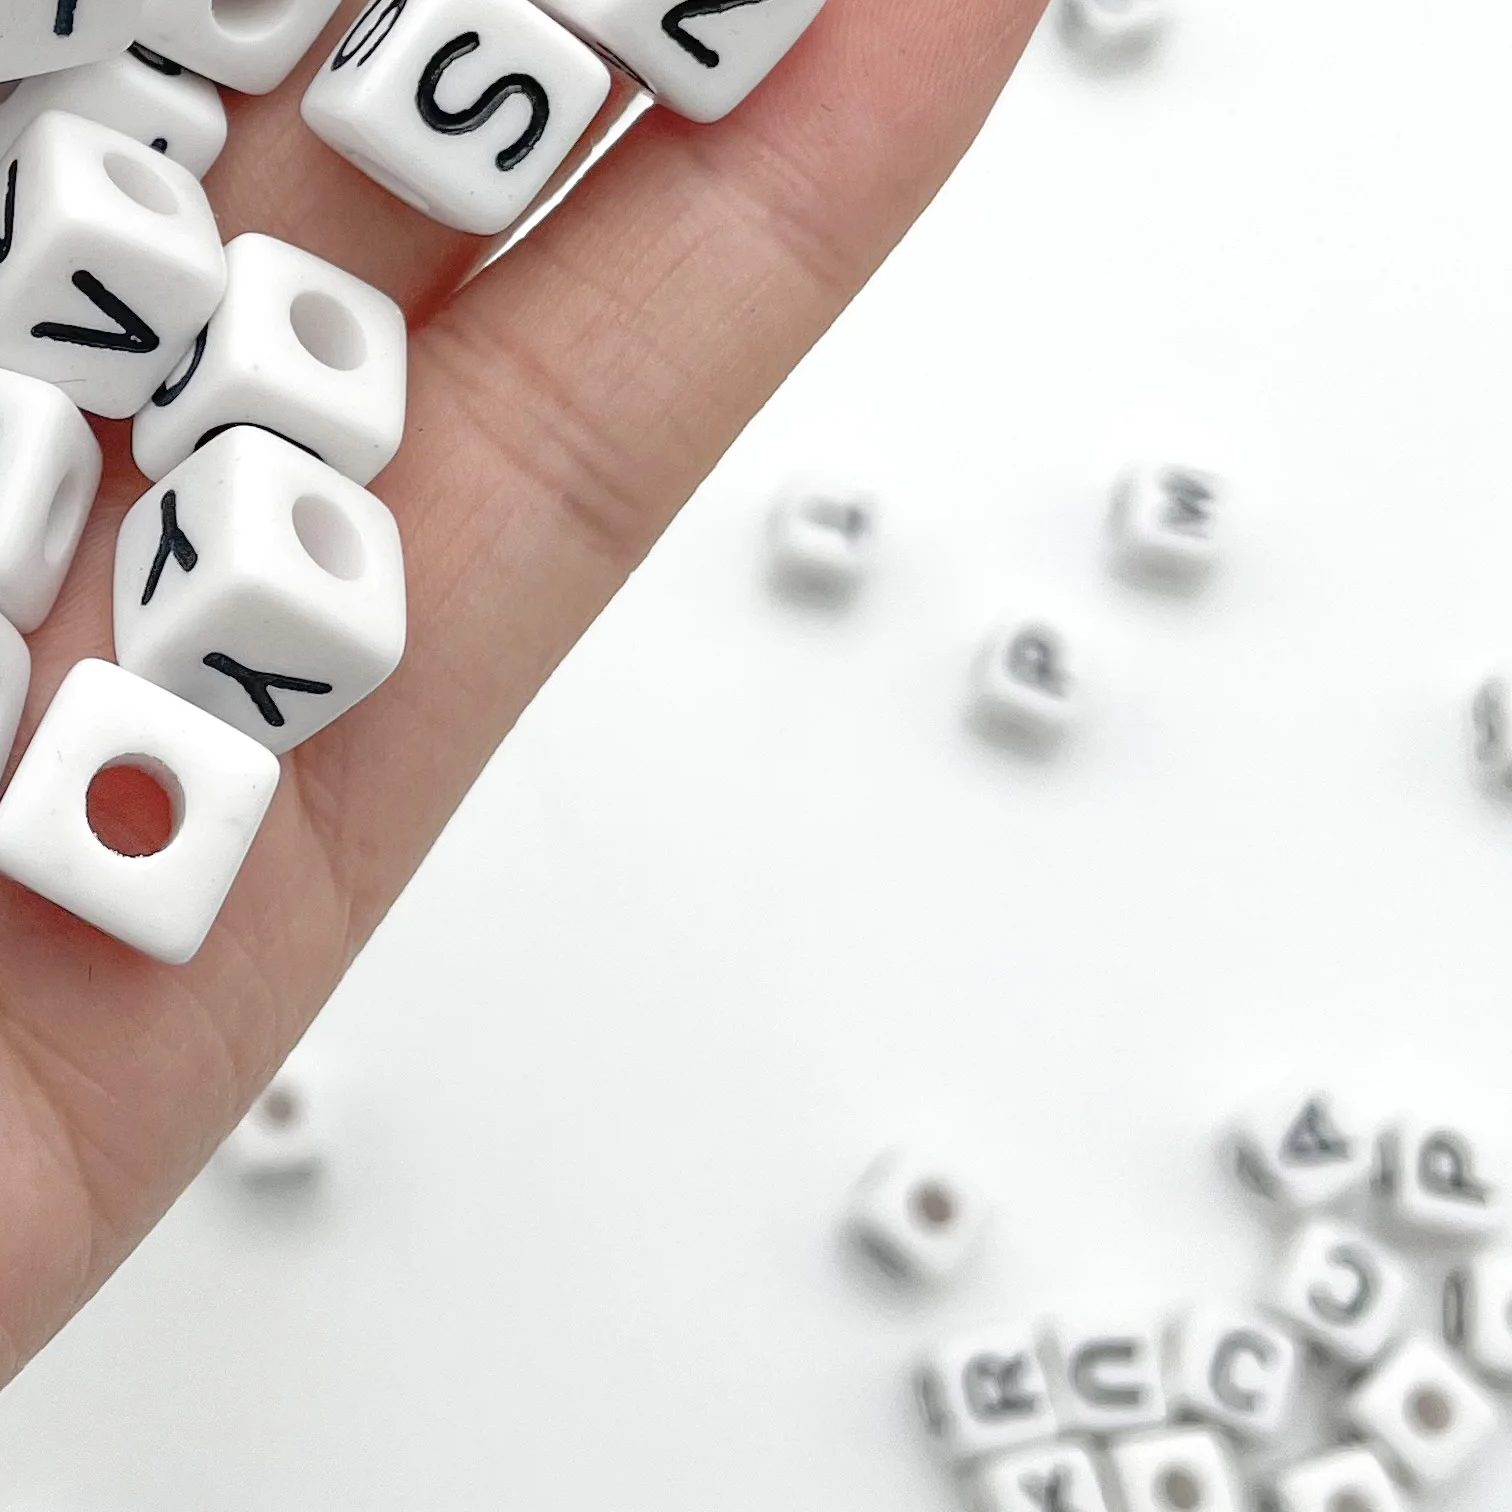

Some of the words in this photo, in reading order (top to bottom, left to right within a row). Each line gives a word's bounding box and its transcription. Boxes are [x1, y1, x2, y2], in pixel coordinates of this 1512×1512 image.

[414, 30, 551, 173] S
[30, 269, 161, 354] V
[140, 488, 199, 607] Y
[201, 650, 334, 728] Y
